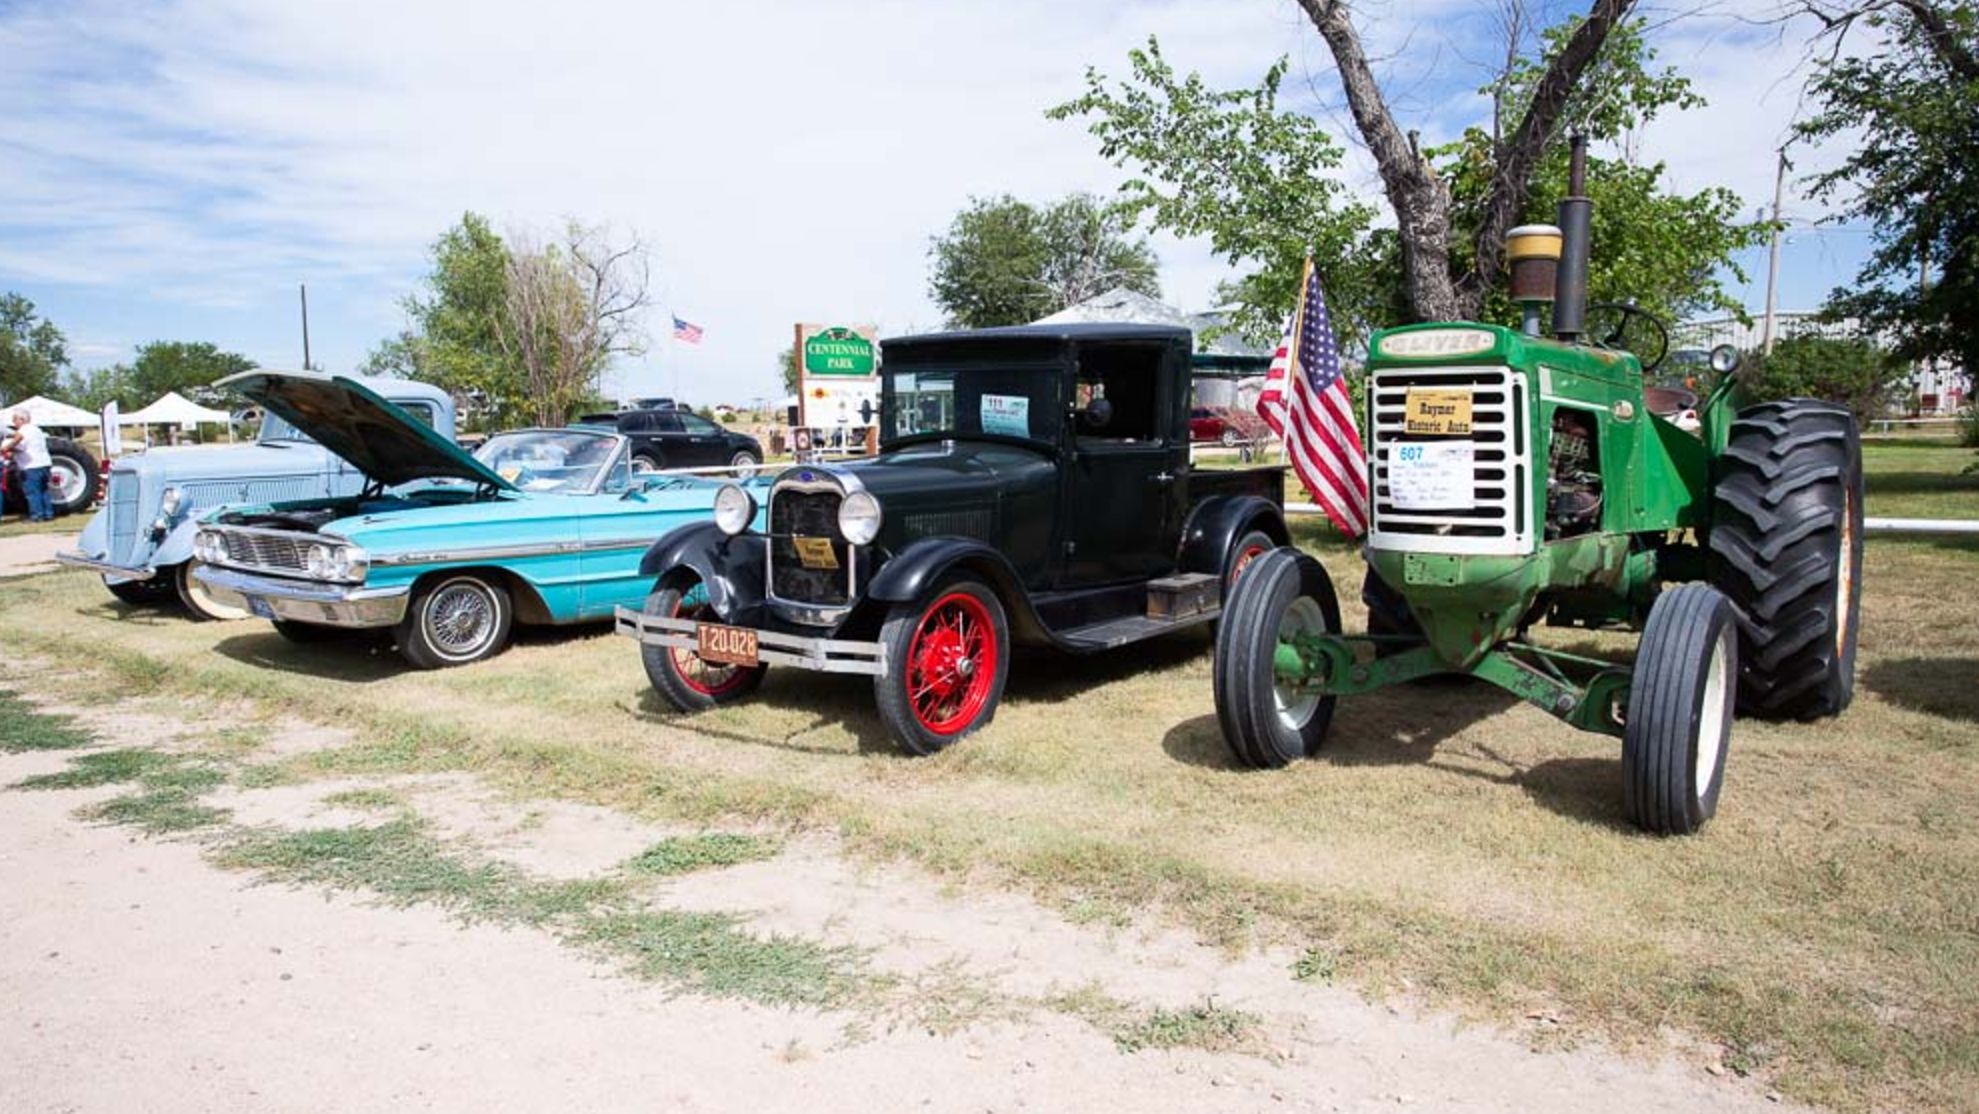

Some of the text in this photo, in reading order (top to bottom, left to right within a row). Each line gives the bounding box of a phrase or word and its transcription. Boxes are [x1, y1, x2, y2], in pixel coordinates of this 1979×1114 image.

[807, 343, 870, 356] CENTENNIAL
[1391, 333, 1481, 353] OLIVER
[827, 358, 855, 369] PARK
[1420, 402, 1456, 418] Raymer
[1447, 419, 1469, 432] Auto
[1400, 446, 1424, 461] 607
